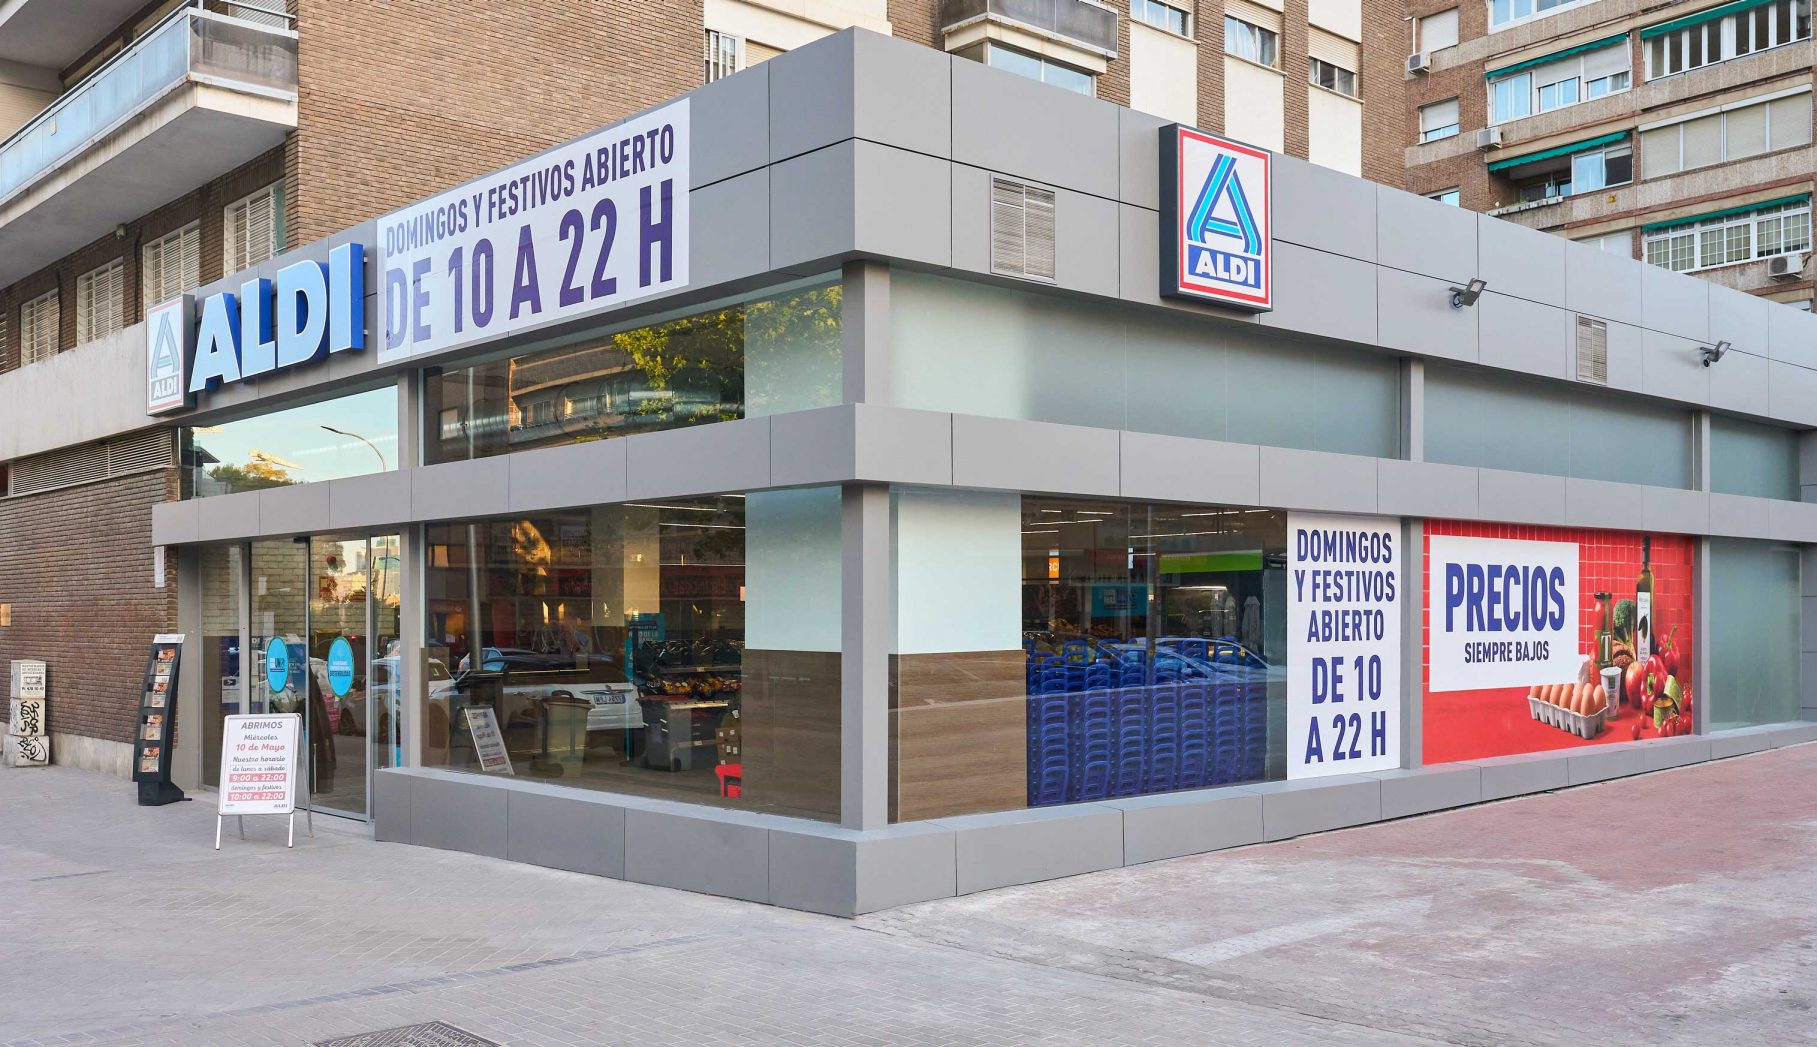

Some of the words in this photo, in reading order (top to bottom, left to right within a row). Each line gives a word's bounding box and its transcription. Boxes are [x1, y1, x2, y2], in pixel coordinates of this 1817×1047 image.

[386, 199, 468, 259] DOMINGOS
[472, 193, 483, 229] Y
[488, 160, 576, 224] FESTIVOS
[581, 123, 675, 195] ABIERTO
[386, 256, 432, 351] DE
[448, 238, 494, 334] 10
[509, 223, 543, 320] A
[559, 198, 618, 309] 22
[639, 178, 674, 288] H
[1194, 250, 1255, 286] ALDI
[189, 242, 363, 393] ALDI
[153, 376, 178, 399] ALDI
[1296, 528, 1393, 564] DOMINGOS
[1295, 569, 1305, 603] Y
[1311, 569, 1396, 603] FESTIVOS
[1445, 563, 1565, 633] PRECIOS
[1307, 608, 1385, 643] ABIERTO
[1464, 641, 1513, 664] SIEMPRE
[1515, 640, 1550, 662] BAJOS
[1312, 656, 1344, 705] DE
[1353, 655, 1382, 702] 10
[241, 721, 283, 730] ABRIMOS
[244, 733, 278, 741] Miércoles
[1304, 716, 1324, 765] A
[1332, 712, 1362, 762] 22
[1372, 710, 1386, 757] H
[236, 743, 246, 751] 10
[248, 743, 259, 751] de
[261, 743, 286, 753] Mayo
